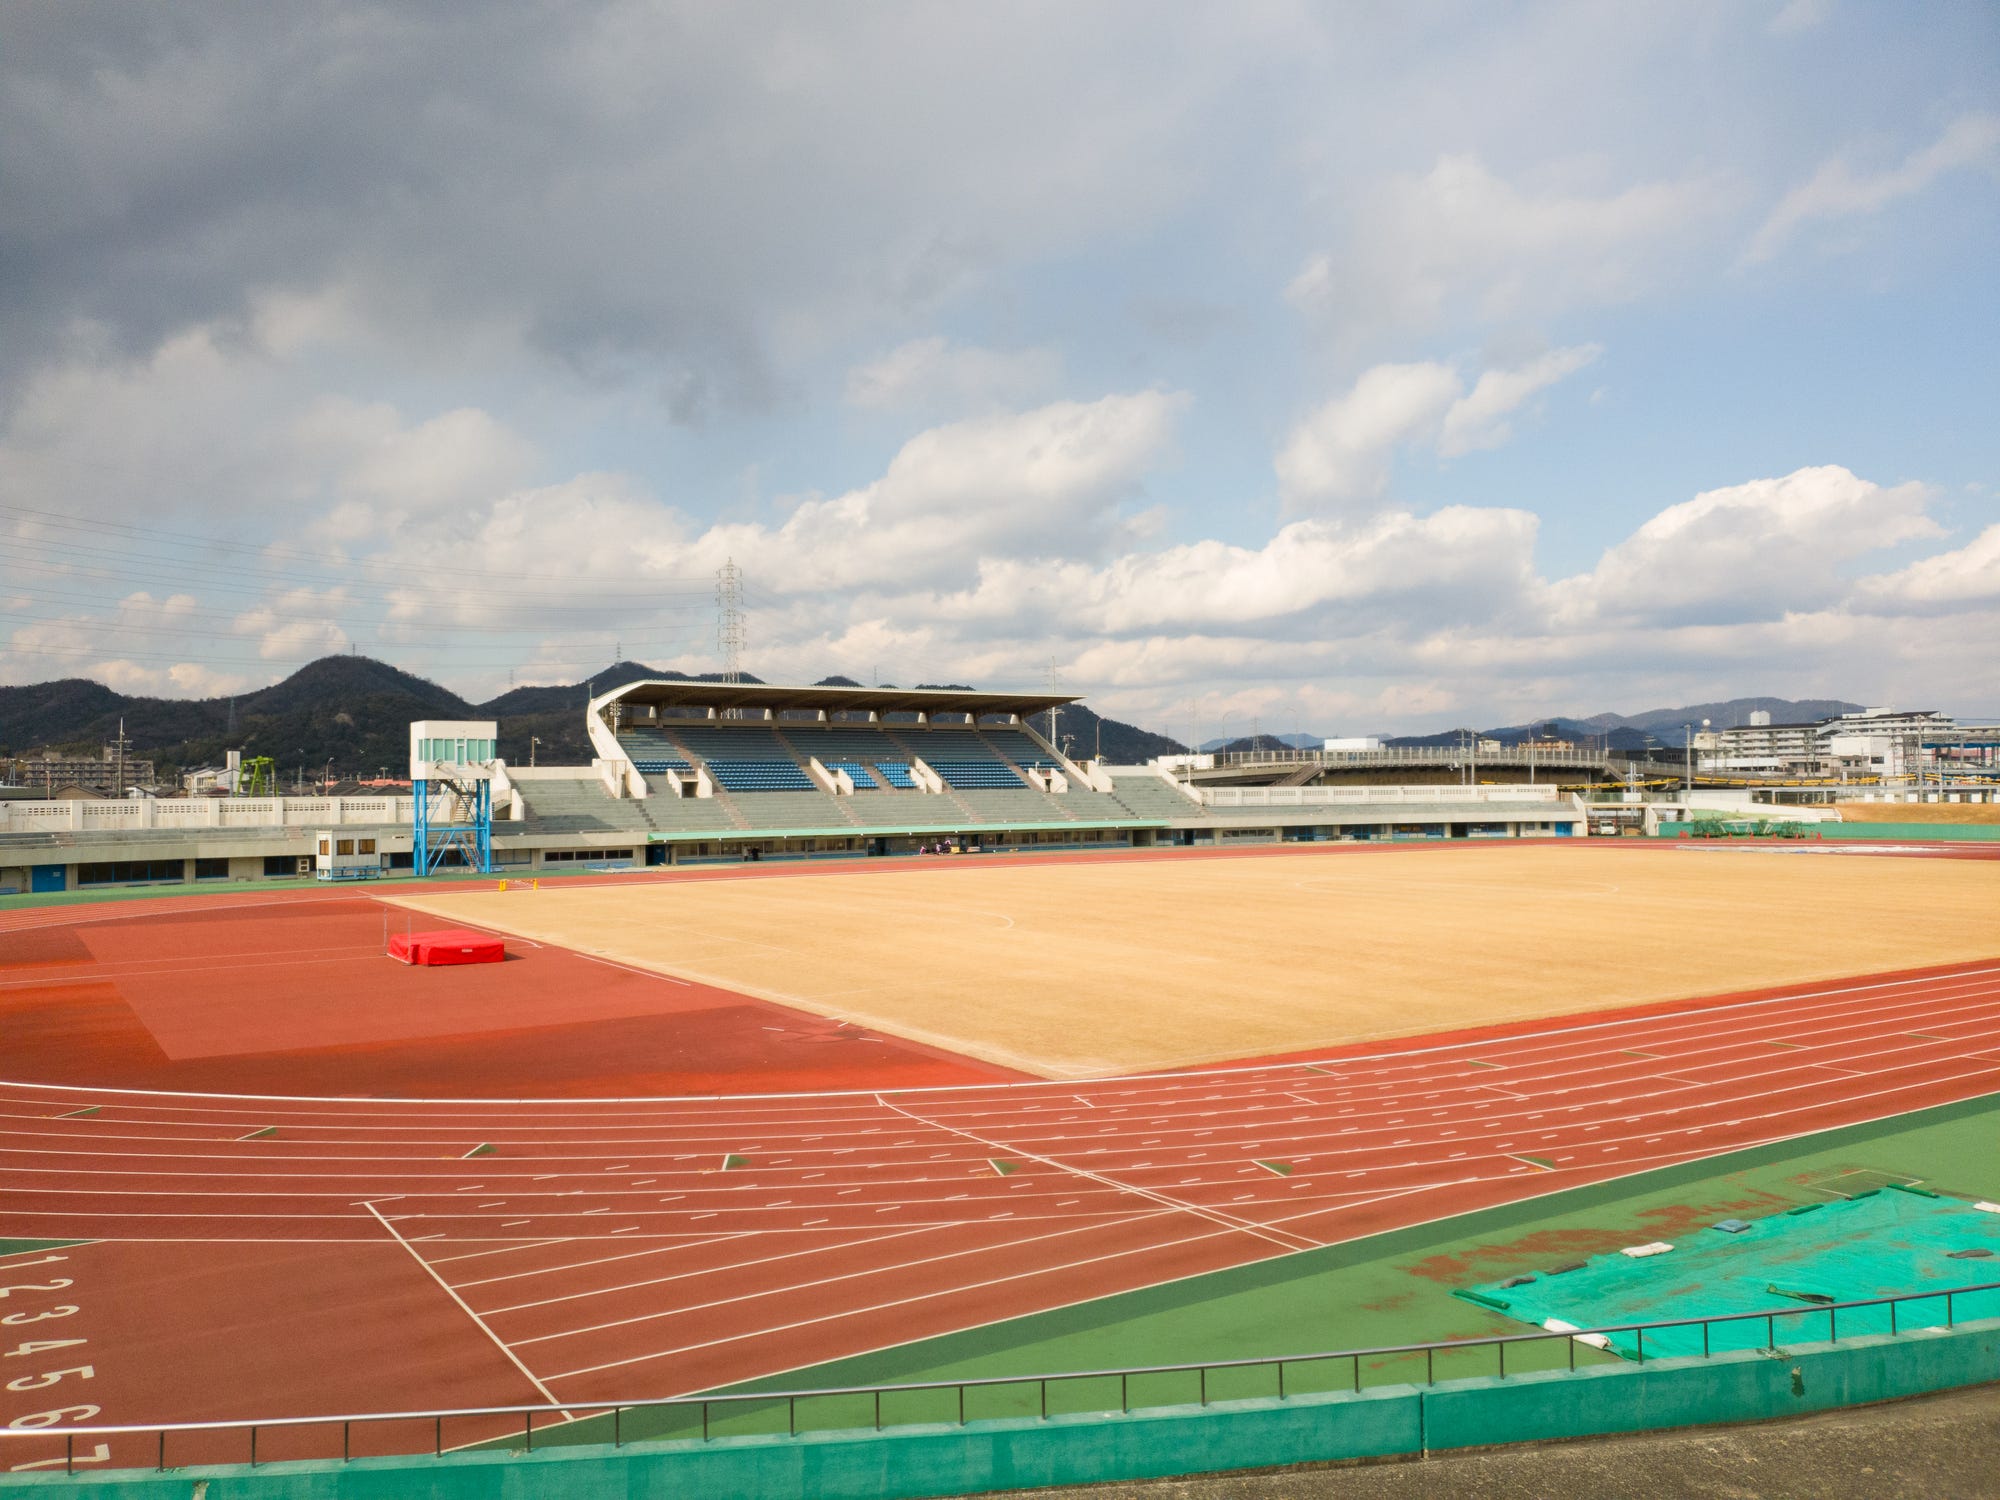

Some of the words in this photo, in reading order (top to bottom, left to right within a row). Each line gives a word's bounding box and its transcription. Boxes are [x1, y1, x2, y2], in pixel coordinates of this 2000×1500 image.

[0, 1255, 69, 1270] 1
[0, 1278, 74, 1298] 2
[1, 1305, 80, 1325] 3
[4, 1338, 88, 1357] 4
[6, 1365, 95, 1391] 5
[9, 1404, 101, 1429] 6
[10, 1443, 111, 1472] 7
